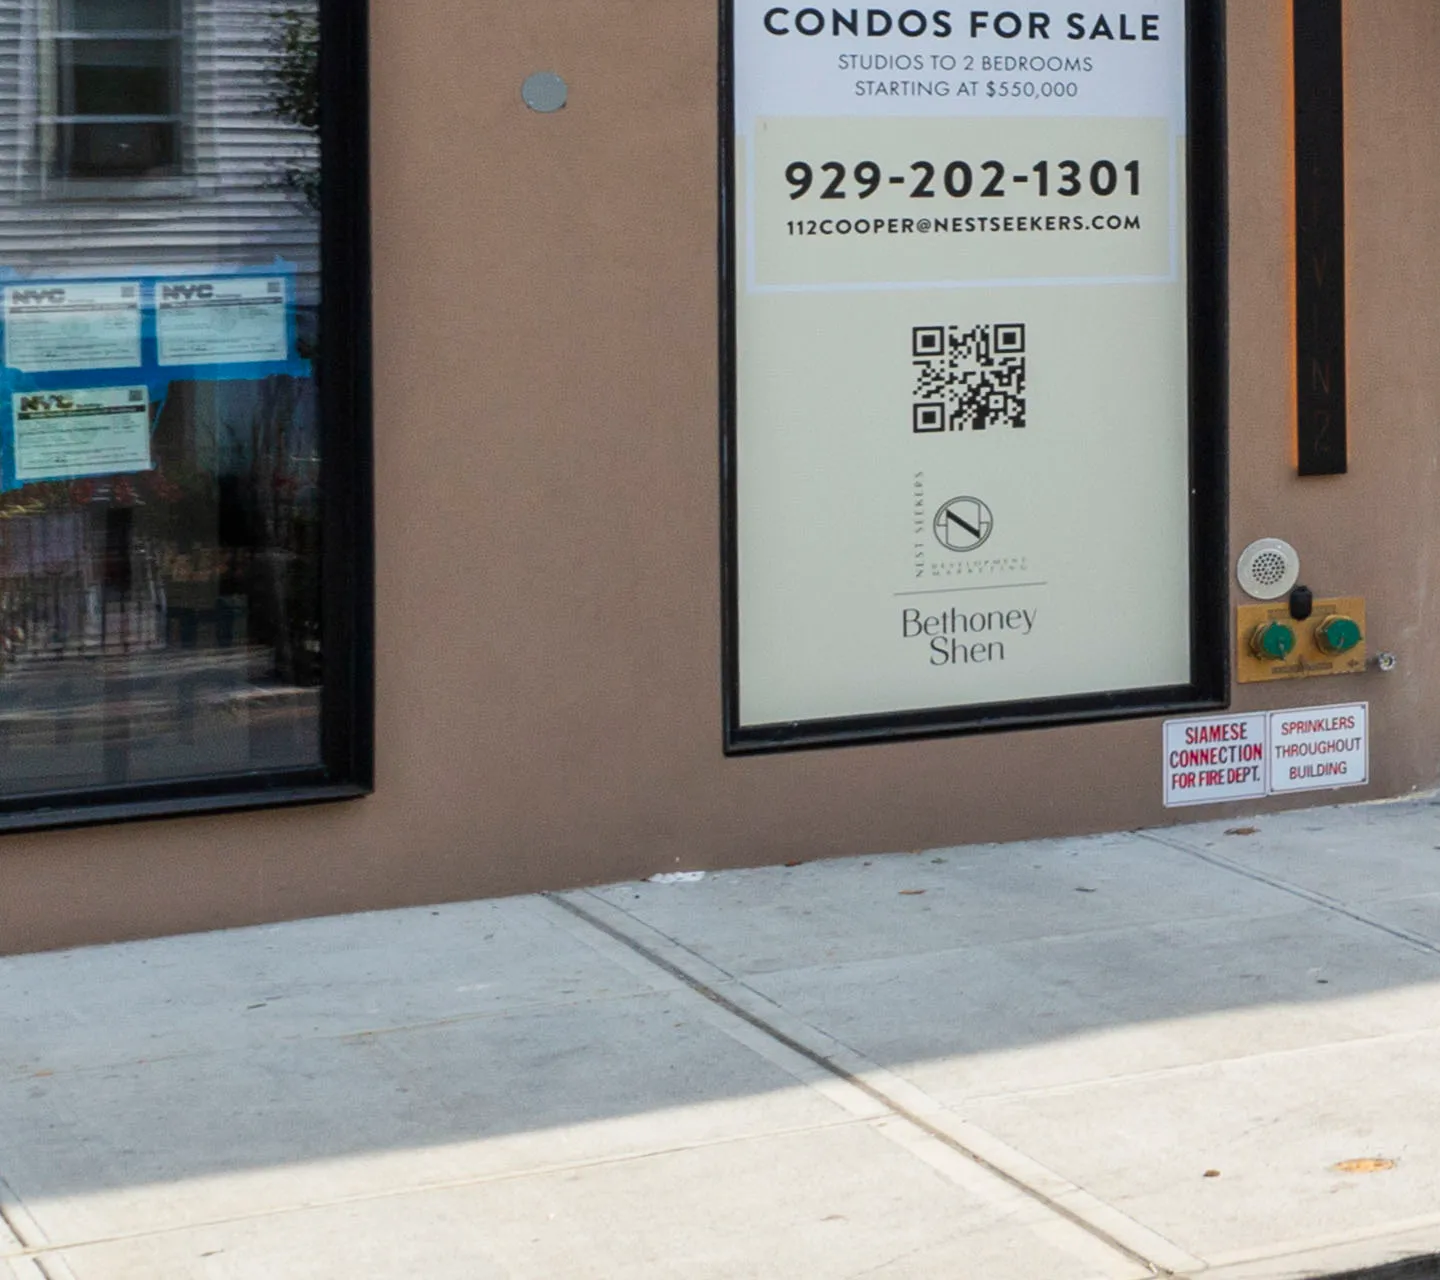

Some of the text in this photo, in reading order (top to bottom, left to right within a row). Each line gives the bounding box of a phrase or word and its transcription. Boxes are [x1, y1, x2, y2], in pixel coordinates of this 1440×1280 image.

[764, 8, 1159, 41] CONDOS FOR SALE
[839, 54, 1093, 72] STUDIOS TO 2 BEDROOMS
[856, 81, 1077, 98] STARTING AT $550,000
[785, 160, 1139, 200] 929-202-1301
[788, 215, 1140, 235] 112COOPER@NESTSEEKERS.COM
[12, 289, 65, 304] NYC
[162, 284, 214, 300] NYC
[20, 395, 73, 411] NYC
[903, 608, 1037, 637] Bethoney
[930, 636, 1004, 665] Shen
[1186, 723, 1248, 744] SIAMESE
[1282, 716, 1355, 735] SPRINKLERS
[1170, 743, 1262, 768] CONNECTION
[1275, 737, 1361, 758] THROUGHOUT
[1172, 766, 1260, 790] FOR FIRE DEPT.
[1289, 761, 1347, 780] BUILDING
